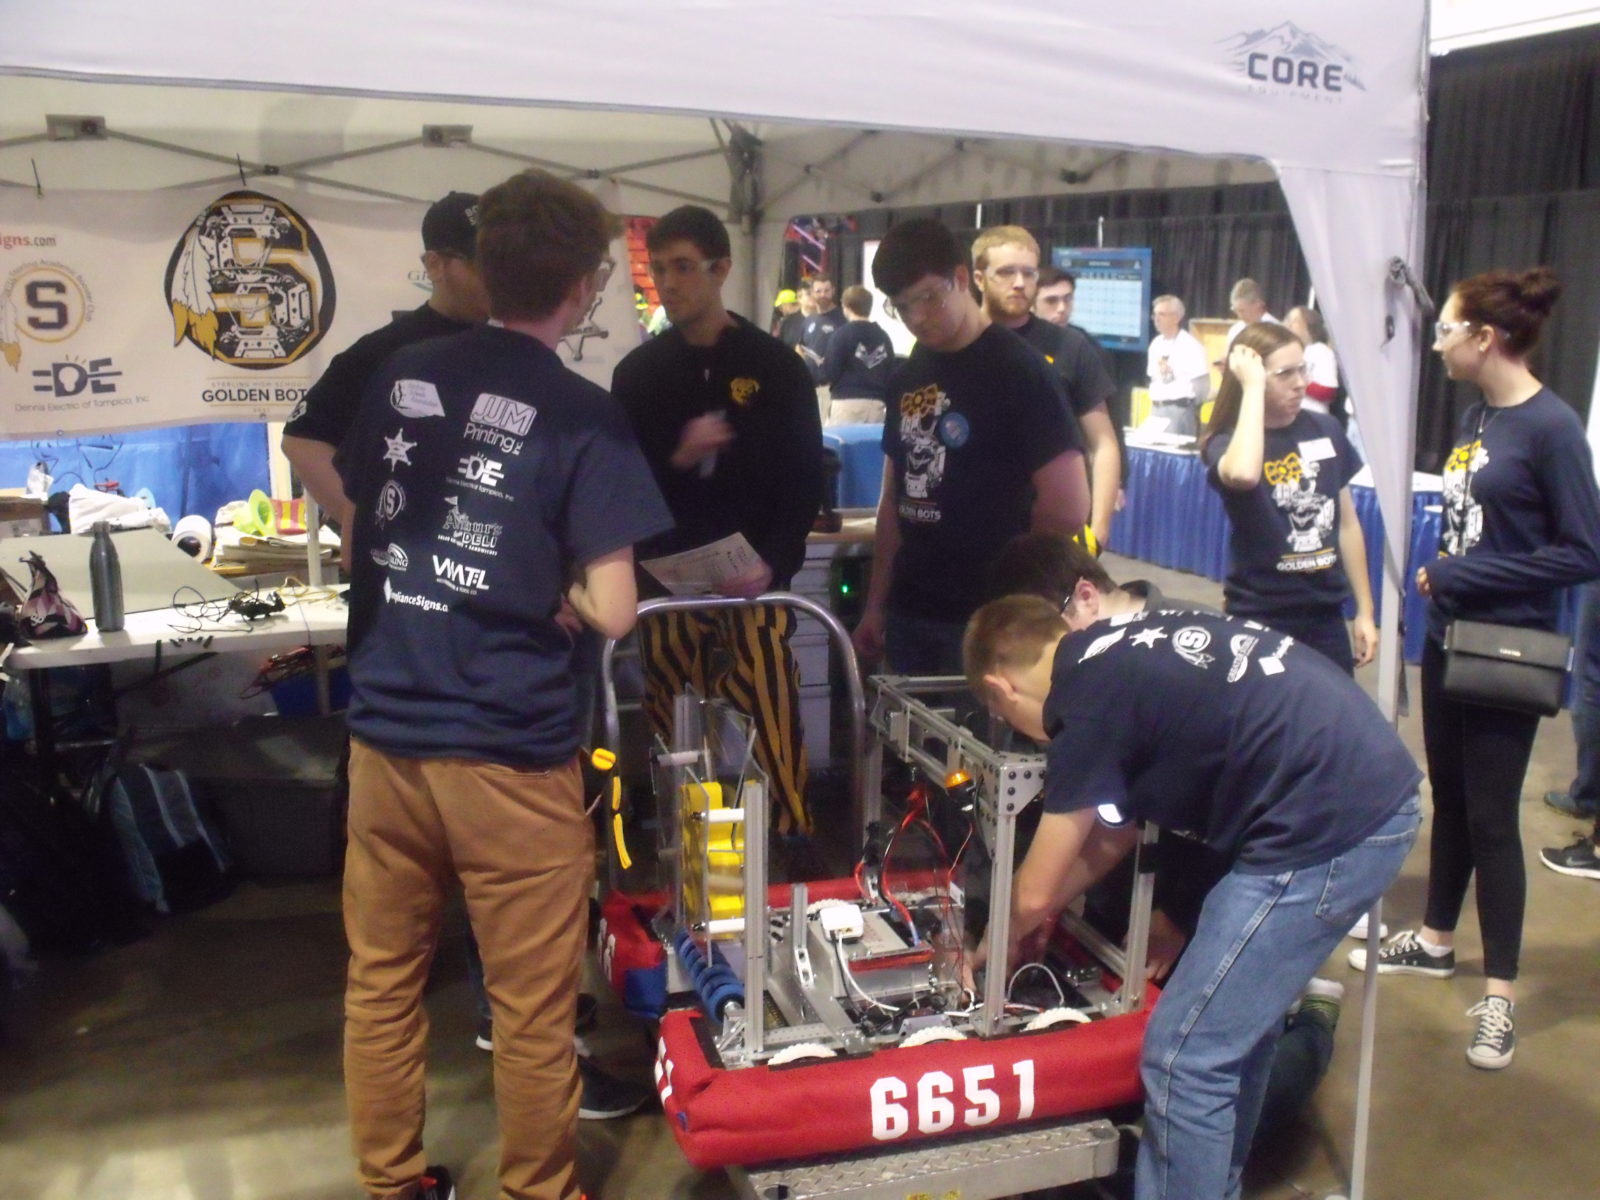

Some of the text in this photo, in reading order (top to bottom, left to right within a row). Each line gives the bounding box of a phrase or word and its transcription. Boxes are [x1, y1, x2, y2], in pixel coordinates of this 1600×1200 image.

[1248, 52, 1343, 92] CORE
[26, 281, 69, 330] S
[202, 389, 270, 402] GOLDEN
[472, 396, 535, 435] JJM
[463, 423, 516, 453] Printing
[917, 509, 942, 521] BOTS
[462, 531, 498, 548] DELI
[1276, 559, 1316, 572] GOLDEN
[869, 1059, 1035, 1142] 6651
